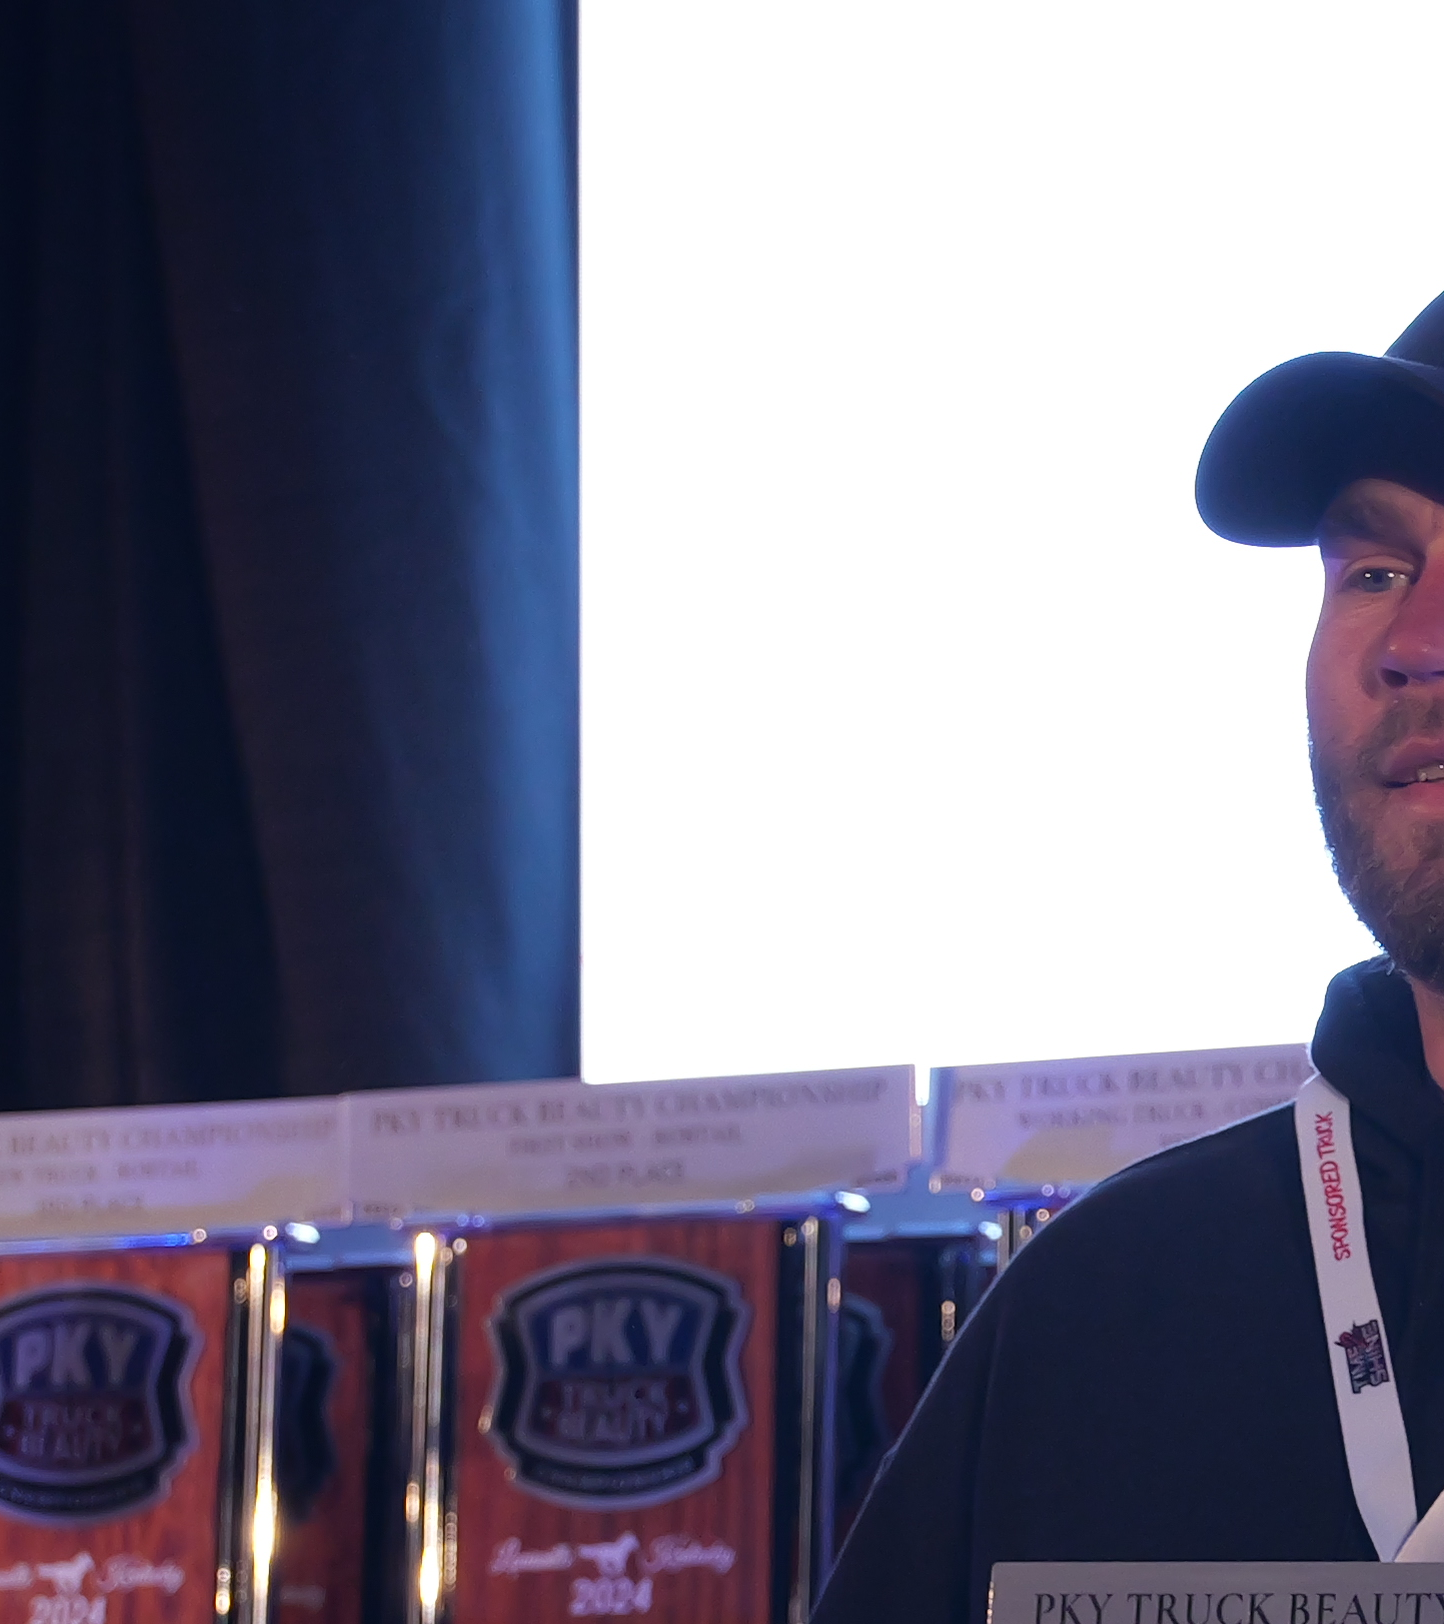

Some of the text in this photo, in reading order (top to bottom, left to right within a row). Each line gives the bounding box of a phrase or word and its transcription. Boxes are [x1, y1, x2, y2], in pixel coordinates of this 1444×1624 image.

[1320, 1161, 1352, 1261] SPONSORED
[12, 1322, 137, 1396] PKY
[548, 1298, 683, 1367] PKY
[568, 1575, 654, 1618] 2024
